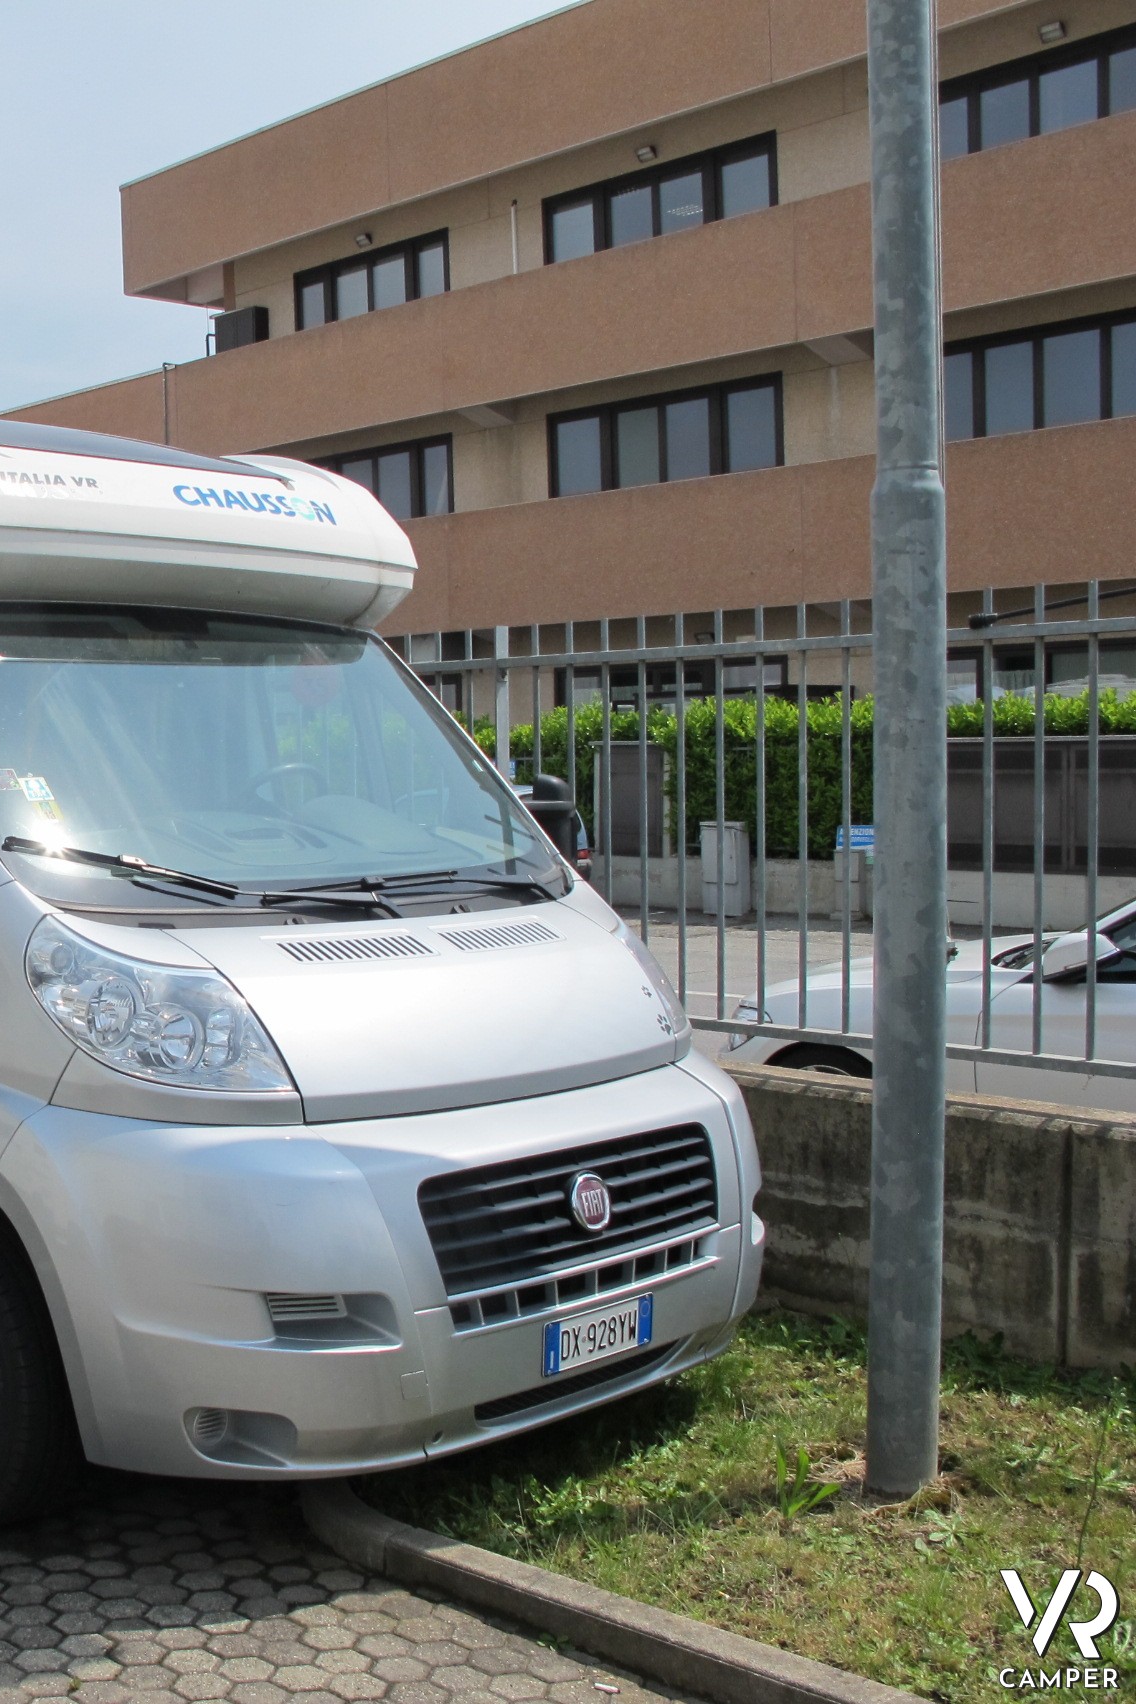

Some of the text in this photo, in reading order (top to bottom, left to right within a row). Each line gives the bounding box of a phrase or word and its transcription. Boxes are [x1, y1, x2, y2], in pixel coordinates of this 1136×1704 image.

[0, 471, 99, 489] ITALIA VR
[172, 485, 337, 526] CHAUSSON
[581, 1188, 604, 1217] FIAT
